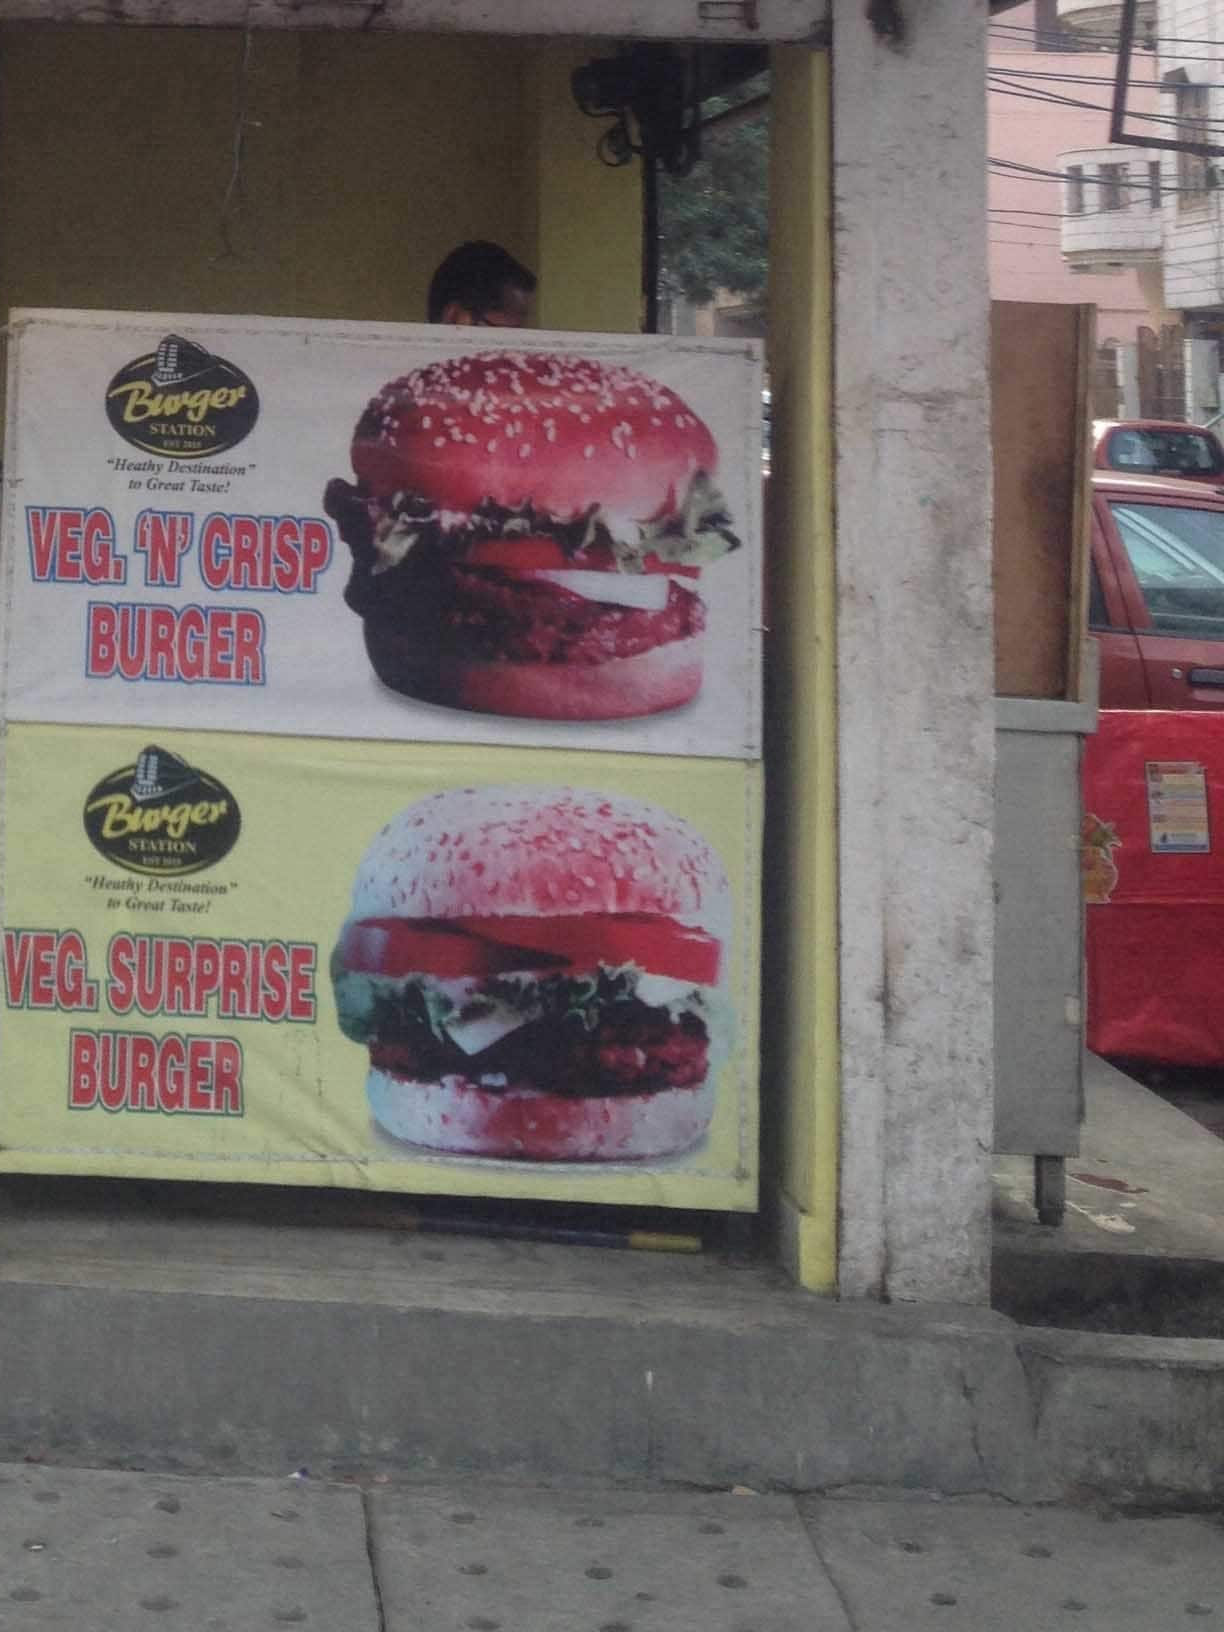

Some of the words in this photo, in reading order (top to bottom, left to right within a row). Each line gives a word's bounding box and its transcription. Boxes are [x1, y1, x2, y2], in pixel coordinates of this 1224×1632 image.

[108, 380, 247, 424] Burger
[149, 423, 217, 437] STATION
[128, 478, 142, 490] to
[146, 476, 185, 492] Great
[191, 478, 231, 494] Taste!
[26, 506, 127, 584] VEG.
[200, 513, 333, 594] CRISP
[85, 601, 266, 685] BURGER
[87, 792, 229, 840] Burger
[127, 839, 198, 856] STATION
[106, 897, 121, 910] to
[125, 895, 165, 912] Great
[170, 898, 212, 914] Taste!
[2, 928, 100, 1013] VEG.
[106, 931, 318, 1024] SURPRISE
[68, 1028, 244, 1117] BURGER
